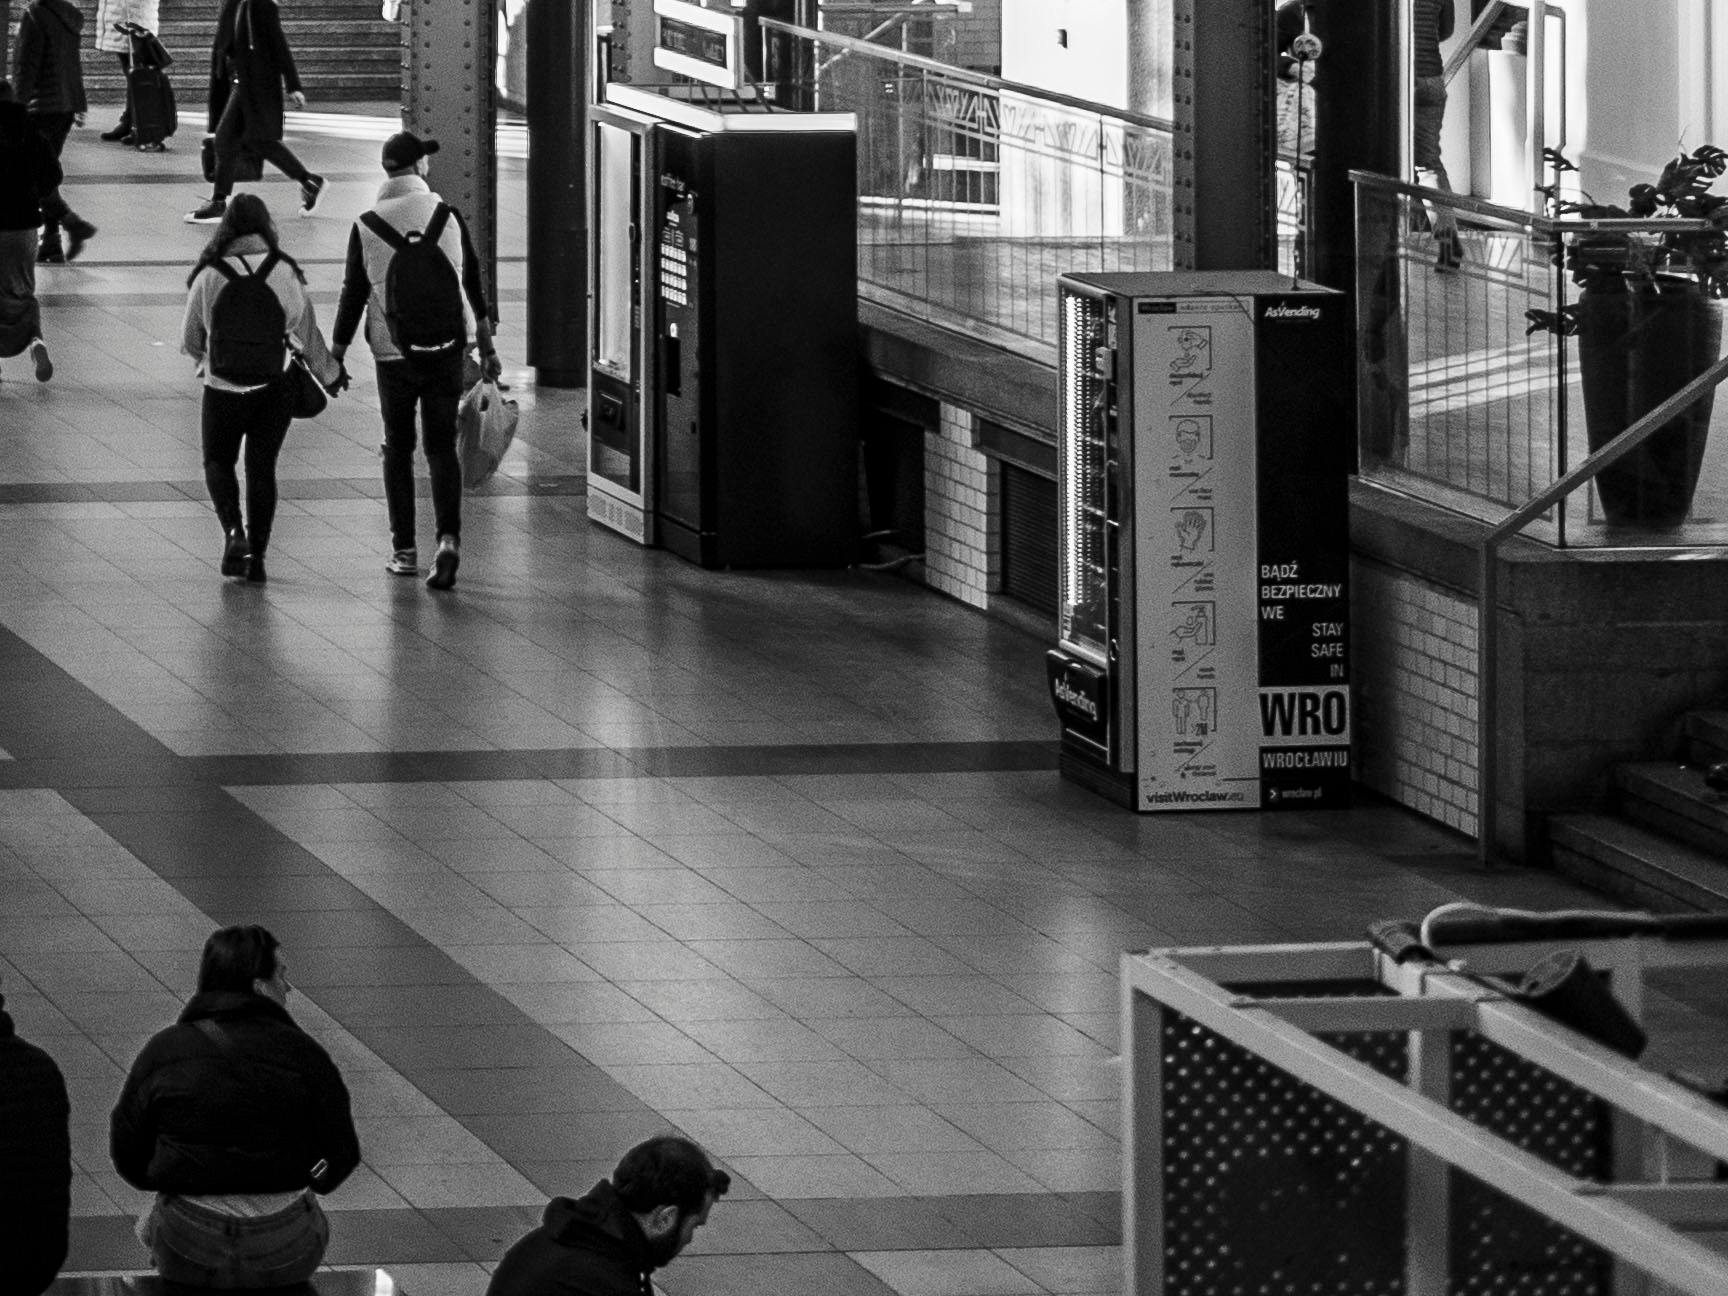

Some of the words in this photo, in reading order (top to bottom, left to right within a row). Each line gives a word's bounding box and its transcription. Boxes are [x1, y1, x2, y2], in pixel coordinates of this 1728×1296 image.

[1264, 301, 1320, 319] AsVending
[1261, 559, 1299, 582] BĄDŹ
[1261, 583, 1342, 599] BEZPIECZNY
[1261, 605, 1285, 620] WE
[1312, 622, 1344, 637] STAY
[1311, 642, 1344, 657] SAFE
[1330, 663, 1344, 677] IN
[1259, 691, 1347, 737] WRO
[1262, 751, 1348, 768] WROCŁAWIU
